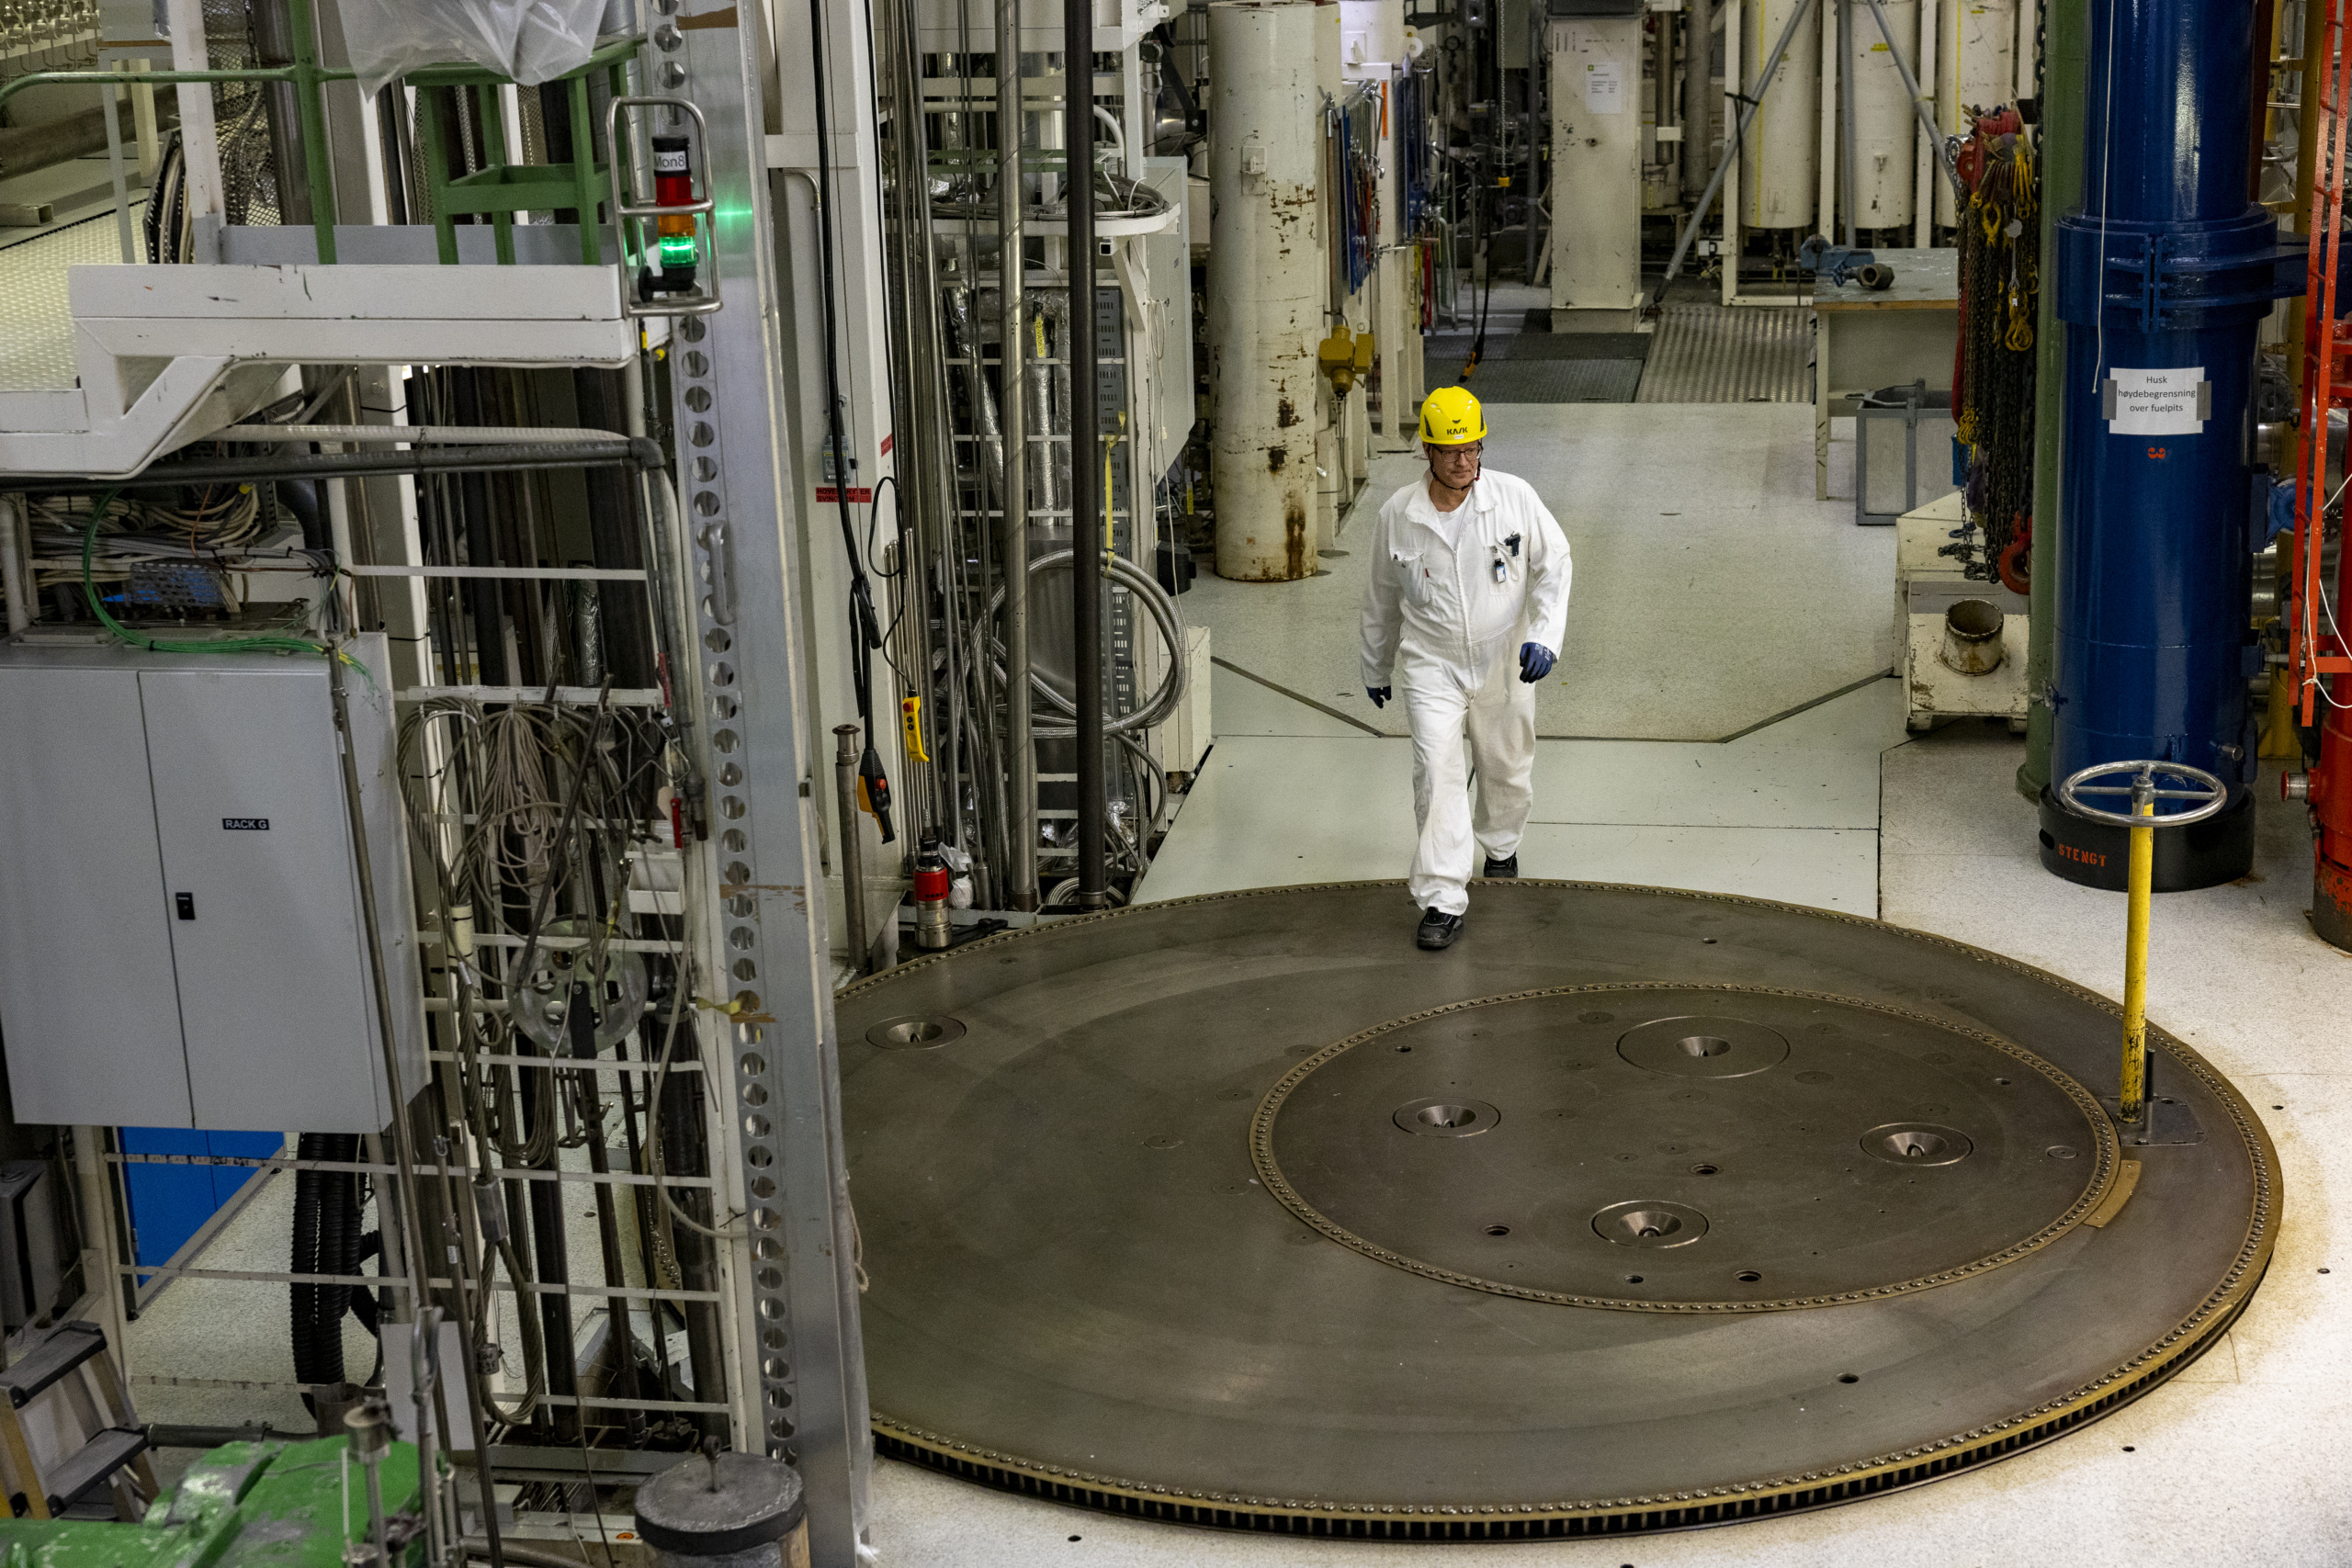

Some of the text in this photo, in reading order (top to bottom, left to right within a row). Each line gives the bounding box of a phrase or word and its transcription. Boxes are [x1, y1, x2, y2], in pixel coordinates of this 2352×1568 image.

[654, 155, 685, 167] Mon8
[2146, 376, 2167, 384] Husk
[2118, 389, 2196, 400] høydebegrensning
[2151, 404, 2184, 413] fuelpits
[224, 819, 267, 829] RACK G
[2058, 843, 2107, 867] STENGT
